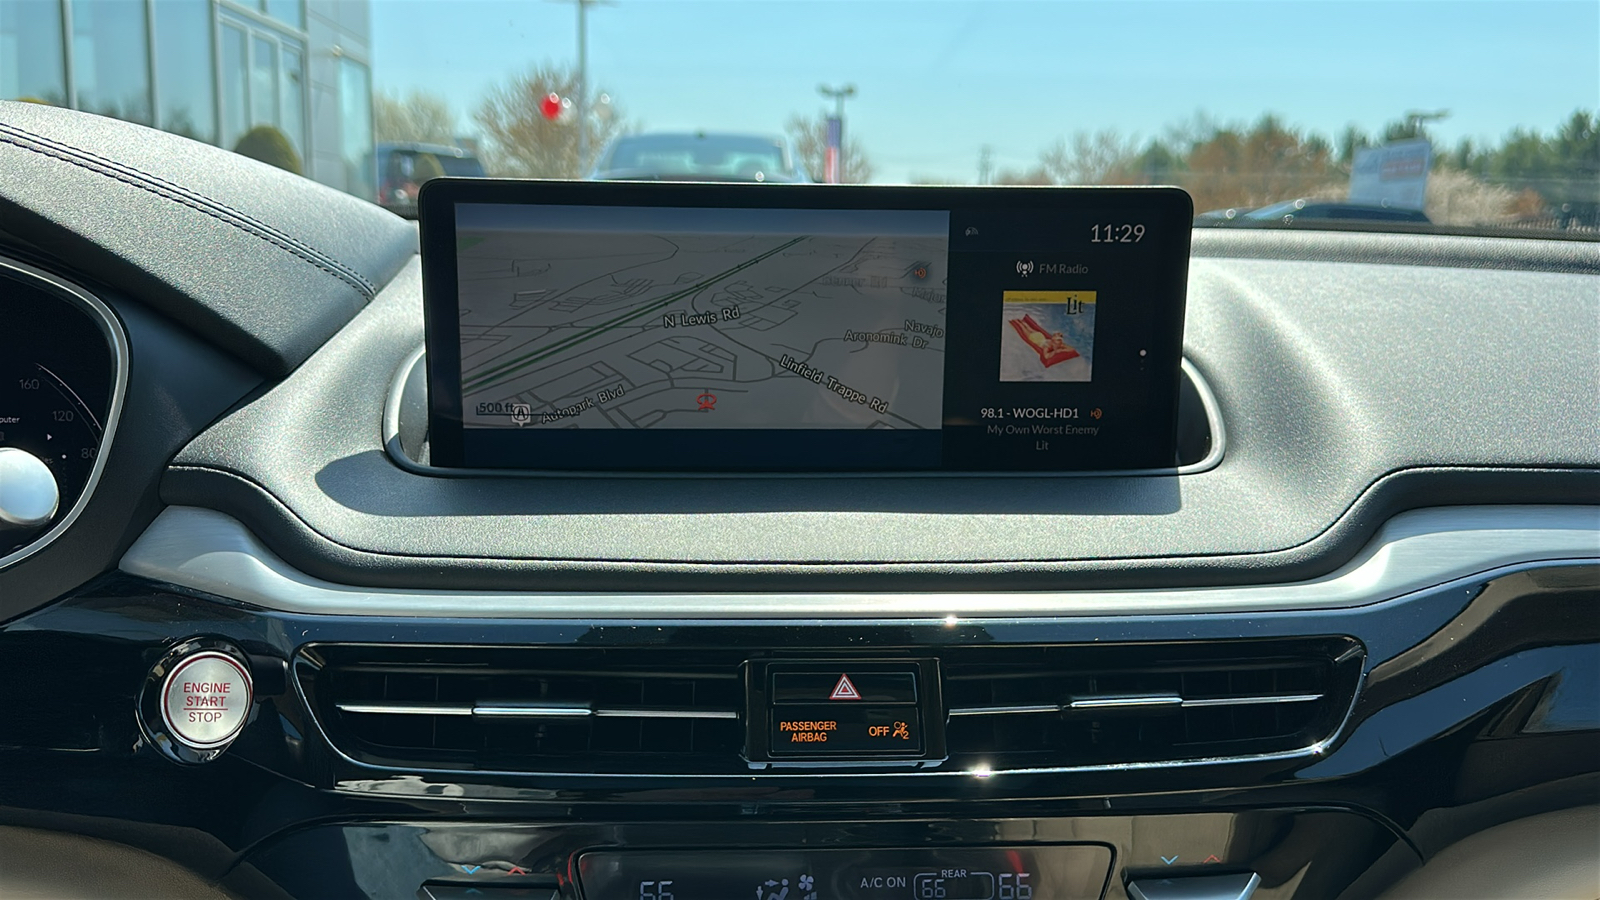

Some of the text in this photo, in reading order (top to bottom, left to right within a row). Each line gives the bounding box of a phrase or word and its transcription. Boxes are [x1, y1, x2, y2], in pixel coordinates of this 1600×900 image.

[1090, 224, 1146, 243] 11:29
[1039, 262, 1089, 275] FM Radio
[1066, 294, 1085, 315] Lit
[663, 305, 741, 328] N Lewis Rd
[904, 320, 944, 338] Navajo
[844, 329, 929, 349] Aronomink Dr
[19, 379, 39, 390] 160
[779, 354, 889, 414] Linfield Trappe Rd
[478, 402, 502, 413] 500
[541, 384, 625, 425] Autopark Blvd
[52, 410, 74, 421] 120
[981, 409, 1003, 418] 98.1
[1012, 409, 1079, 418] WOGL-HD1
[987, 425, 1099, 436] My Own Worst Enemy
[1036, 441, 1049, 450] Lit
[183, 682, 231, 693] ENGINE
[186, 696, 226, 706] START
[188, 712, 222, 722] STOP
[780, 721, 837, 731] PASSENGER
[868, 726, 890, 736] OFF
[791, 732, 828, 742] AIRBAG
[941, 869, 967, 878] REAR
[860, 877, 906, 889] A/C ON
[922, 879, 946, 898] 66
[1000, 873, 1032, 900] 66
